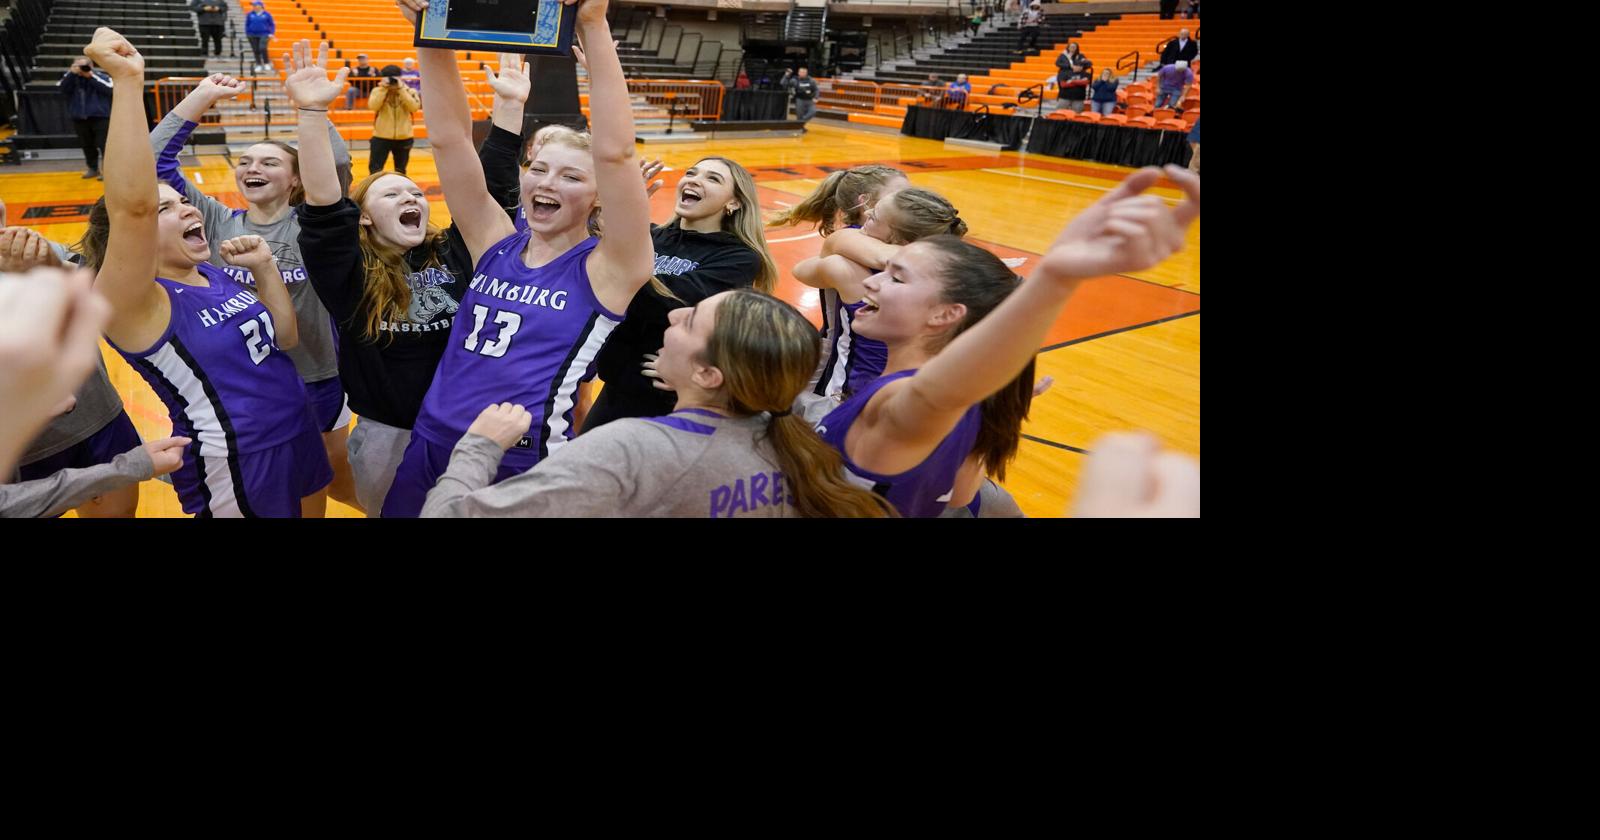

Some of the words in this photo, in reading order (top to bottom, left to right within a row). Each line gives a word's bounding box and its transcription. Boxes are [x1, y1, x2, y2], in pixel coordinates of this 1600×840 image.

[197, 290, 259, 328] HAMBU
[469, 271, 568, 311] HAMBURG
[239, 311, 275, 366] 21
[379, 316, 457, 333] BASKETB
[465, 304, 522, 358] 13
[710, 472, 794, 518] PARE
